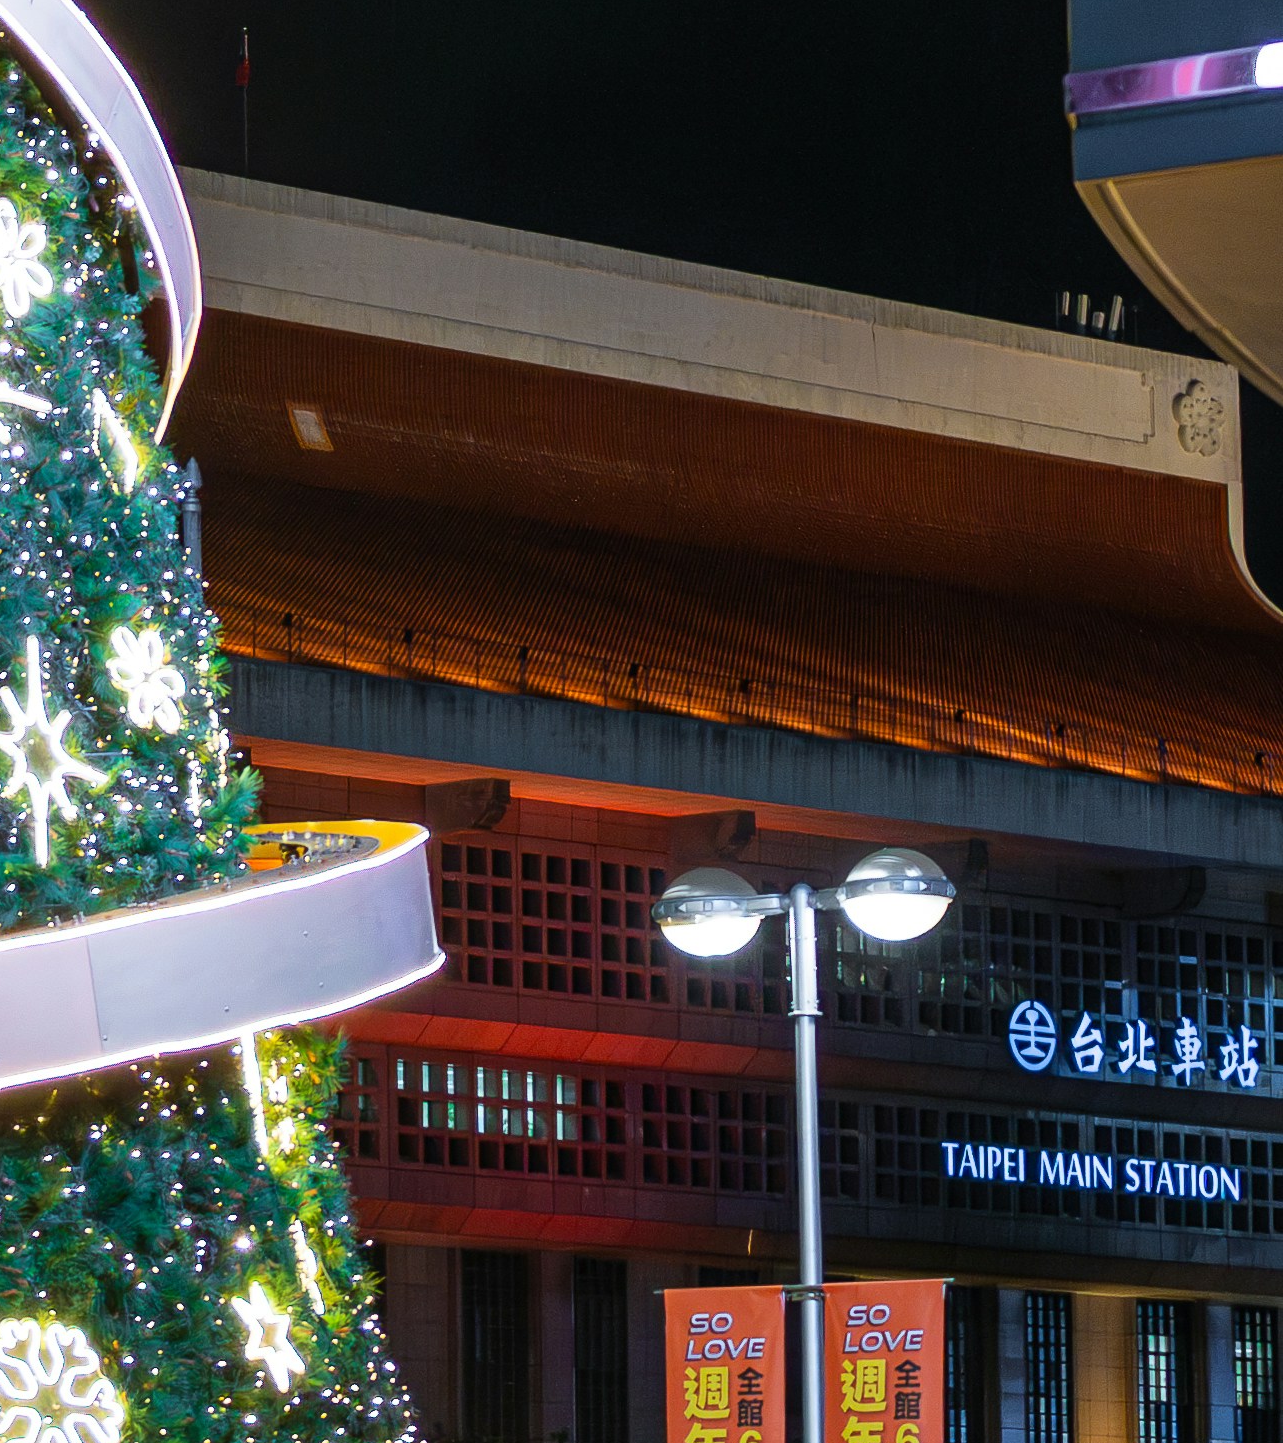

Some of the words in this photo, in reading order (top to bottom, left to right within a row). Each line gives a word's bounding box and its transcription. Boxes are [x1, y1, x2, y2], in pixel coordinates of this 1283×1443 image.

[1071, 1012, 1260, 1088] 台北車站
[942, 1142, 1026, 1182] TAIPEI
[1040, 1150, 1113, 1190] MAIN
[1125, 1158, 1241, 1201] STATION
[689, 1312, 733, 1335] SO
[847, 1304, 890, 1326] SO
[685, 1337, 766, 1362] LOVE
[843, 1328, 923, 1353] LOVE
